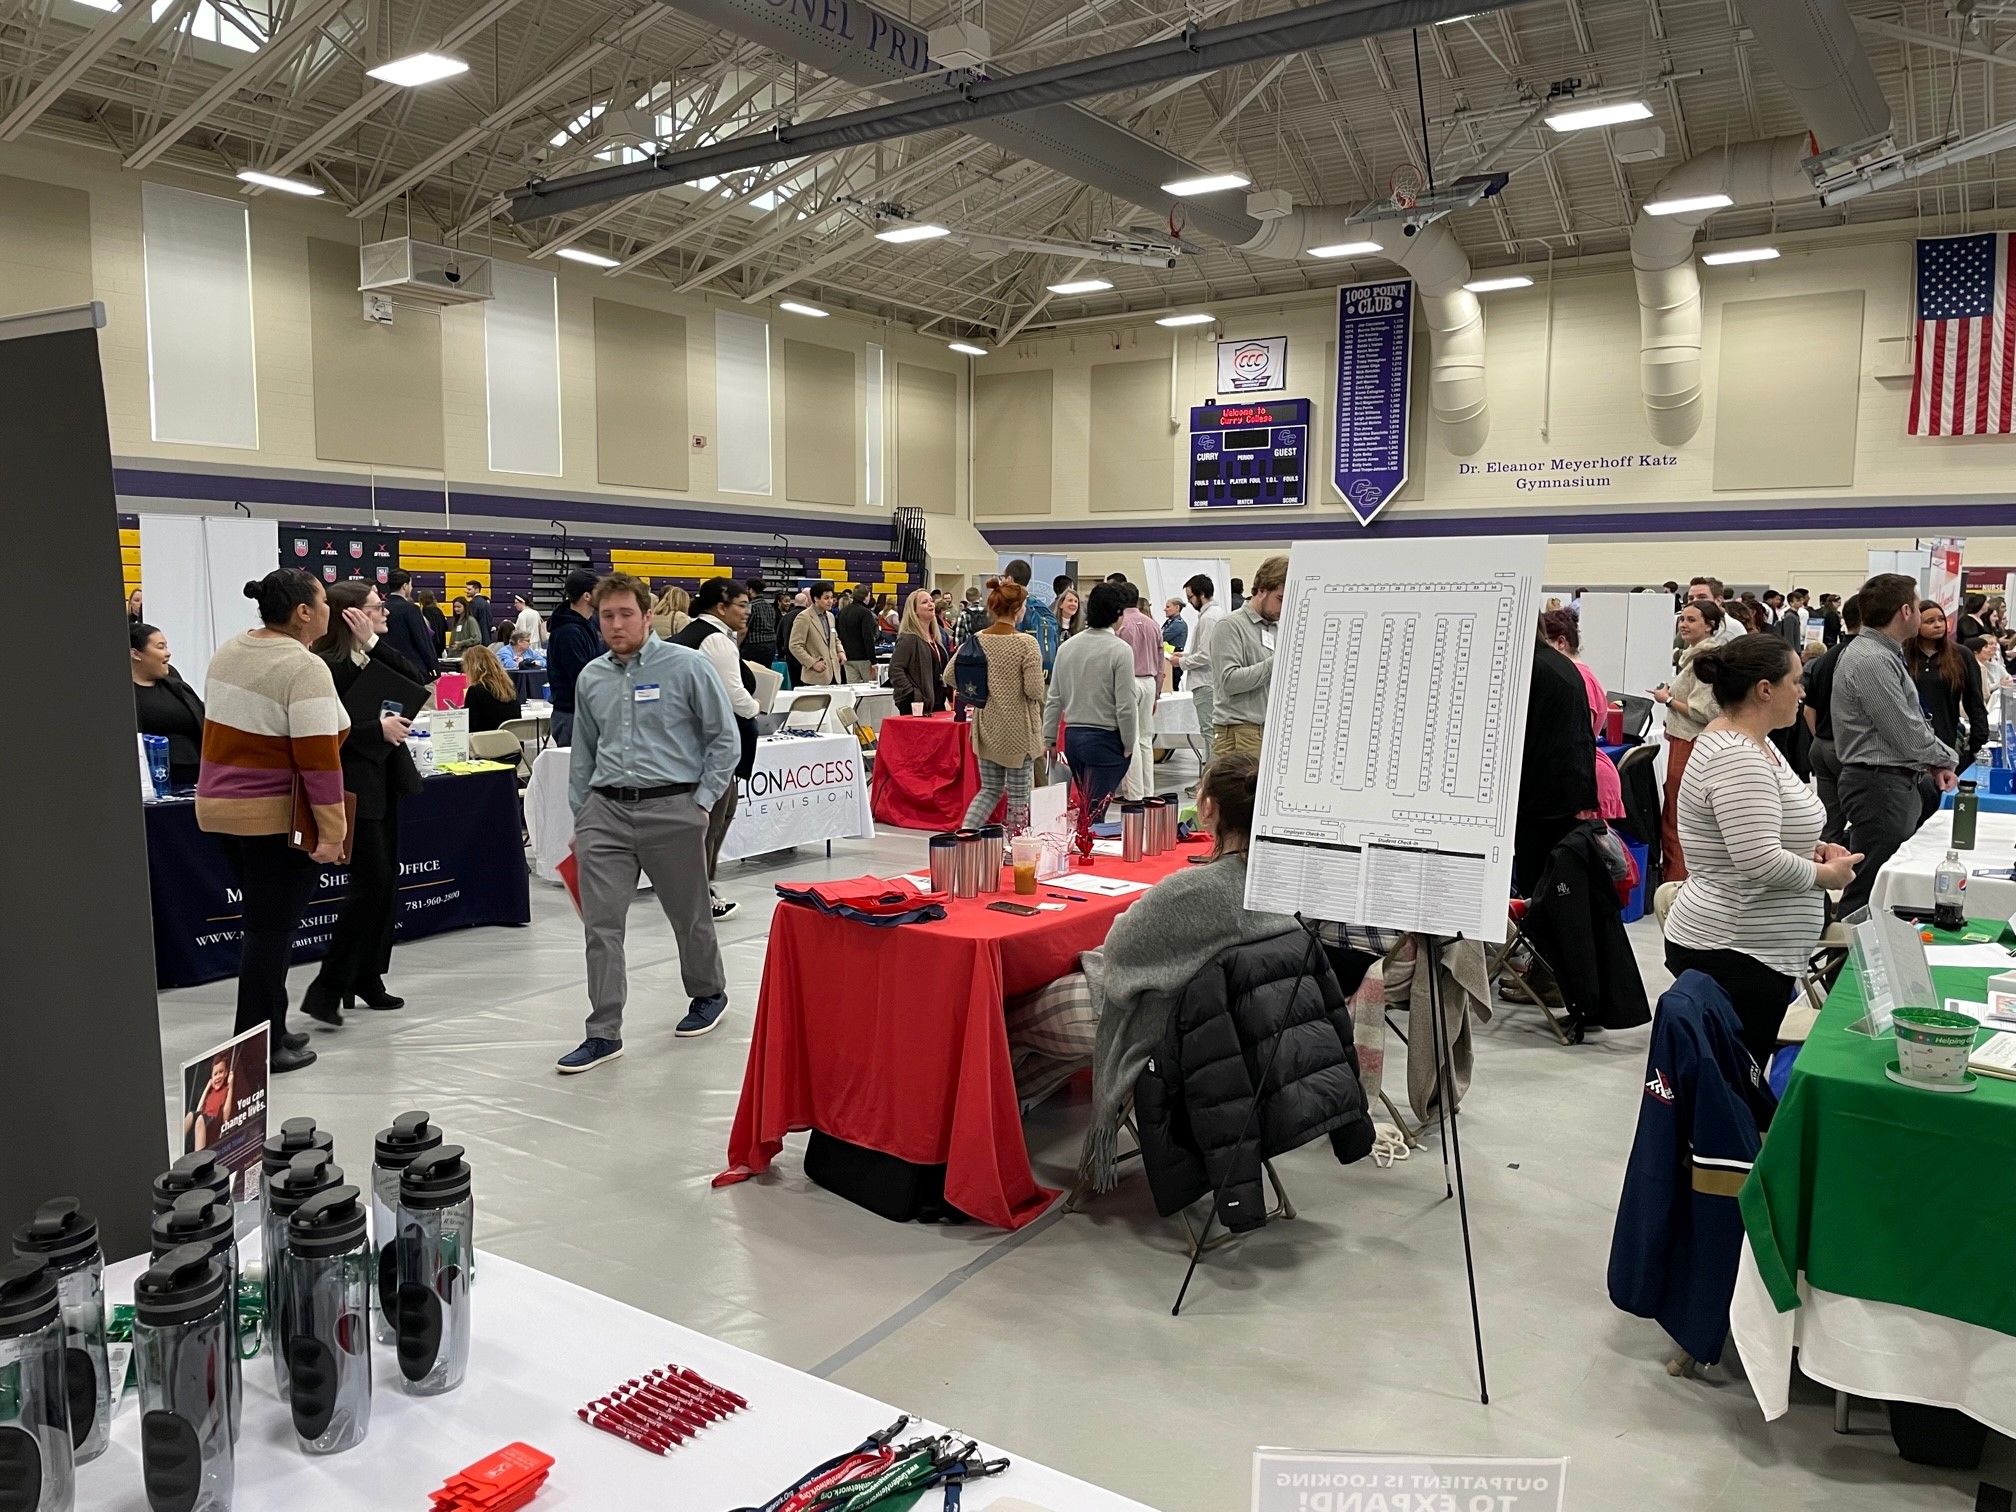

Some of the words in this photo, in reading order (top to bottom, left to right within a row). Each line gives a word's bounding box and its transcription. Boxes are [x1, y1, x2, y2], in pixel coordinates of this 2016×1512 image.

[1345, 288, 1370, 305] 1000
[1372, 284, 1406, 298] POINT
[1358, 296, 1393, 314] CLUB
[1239, 354, 1264, 368] CCC
[1223, 409, 1253, 417] Welcome
[1257, 407, 1266, 415] to
[1220, 416, 1242, 425] Curry
[1197, 452, 1219, 461] CURRY
[1274, 448, 1297, 456] GUEST
[1459, 464, 1480, 474] Dr.
[1486, 462, 1545, 473] Eleanor
[1550, 456, 1633, 472] Meyerhoff
[1638, 454, 1677, 466] Katz
[1516, 476, 1610, 491] Gymnasium
[1283, 828, 1306, 837] Employer
[406, 890, 460, 911] 781-960-2800
[1935, 1037, 1965, 1046] Helping
[237, 1097, 251, 1110] You
[251, 1089, 264, 1103] can
[220, 1112, 247, 1133] change
[248, 1102, 266, 1117] lives.
